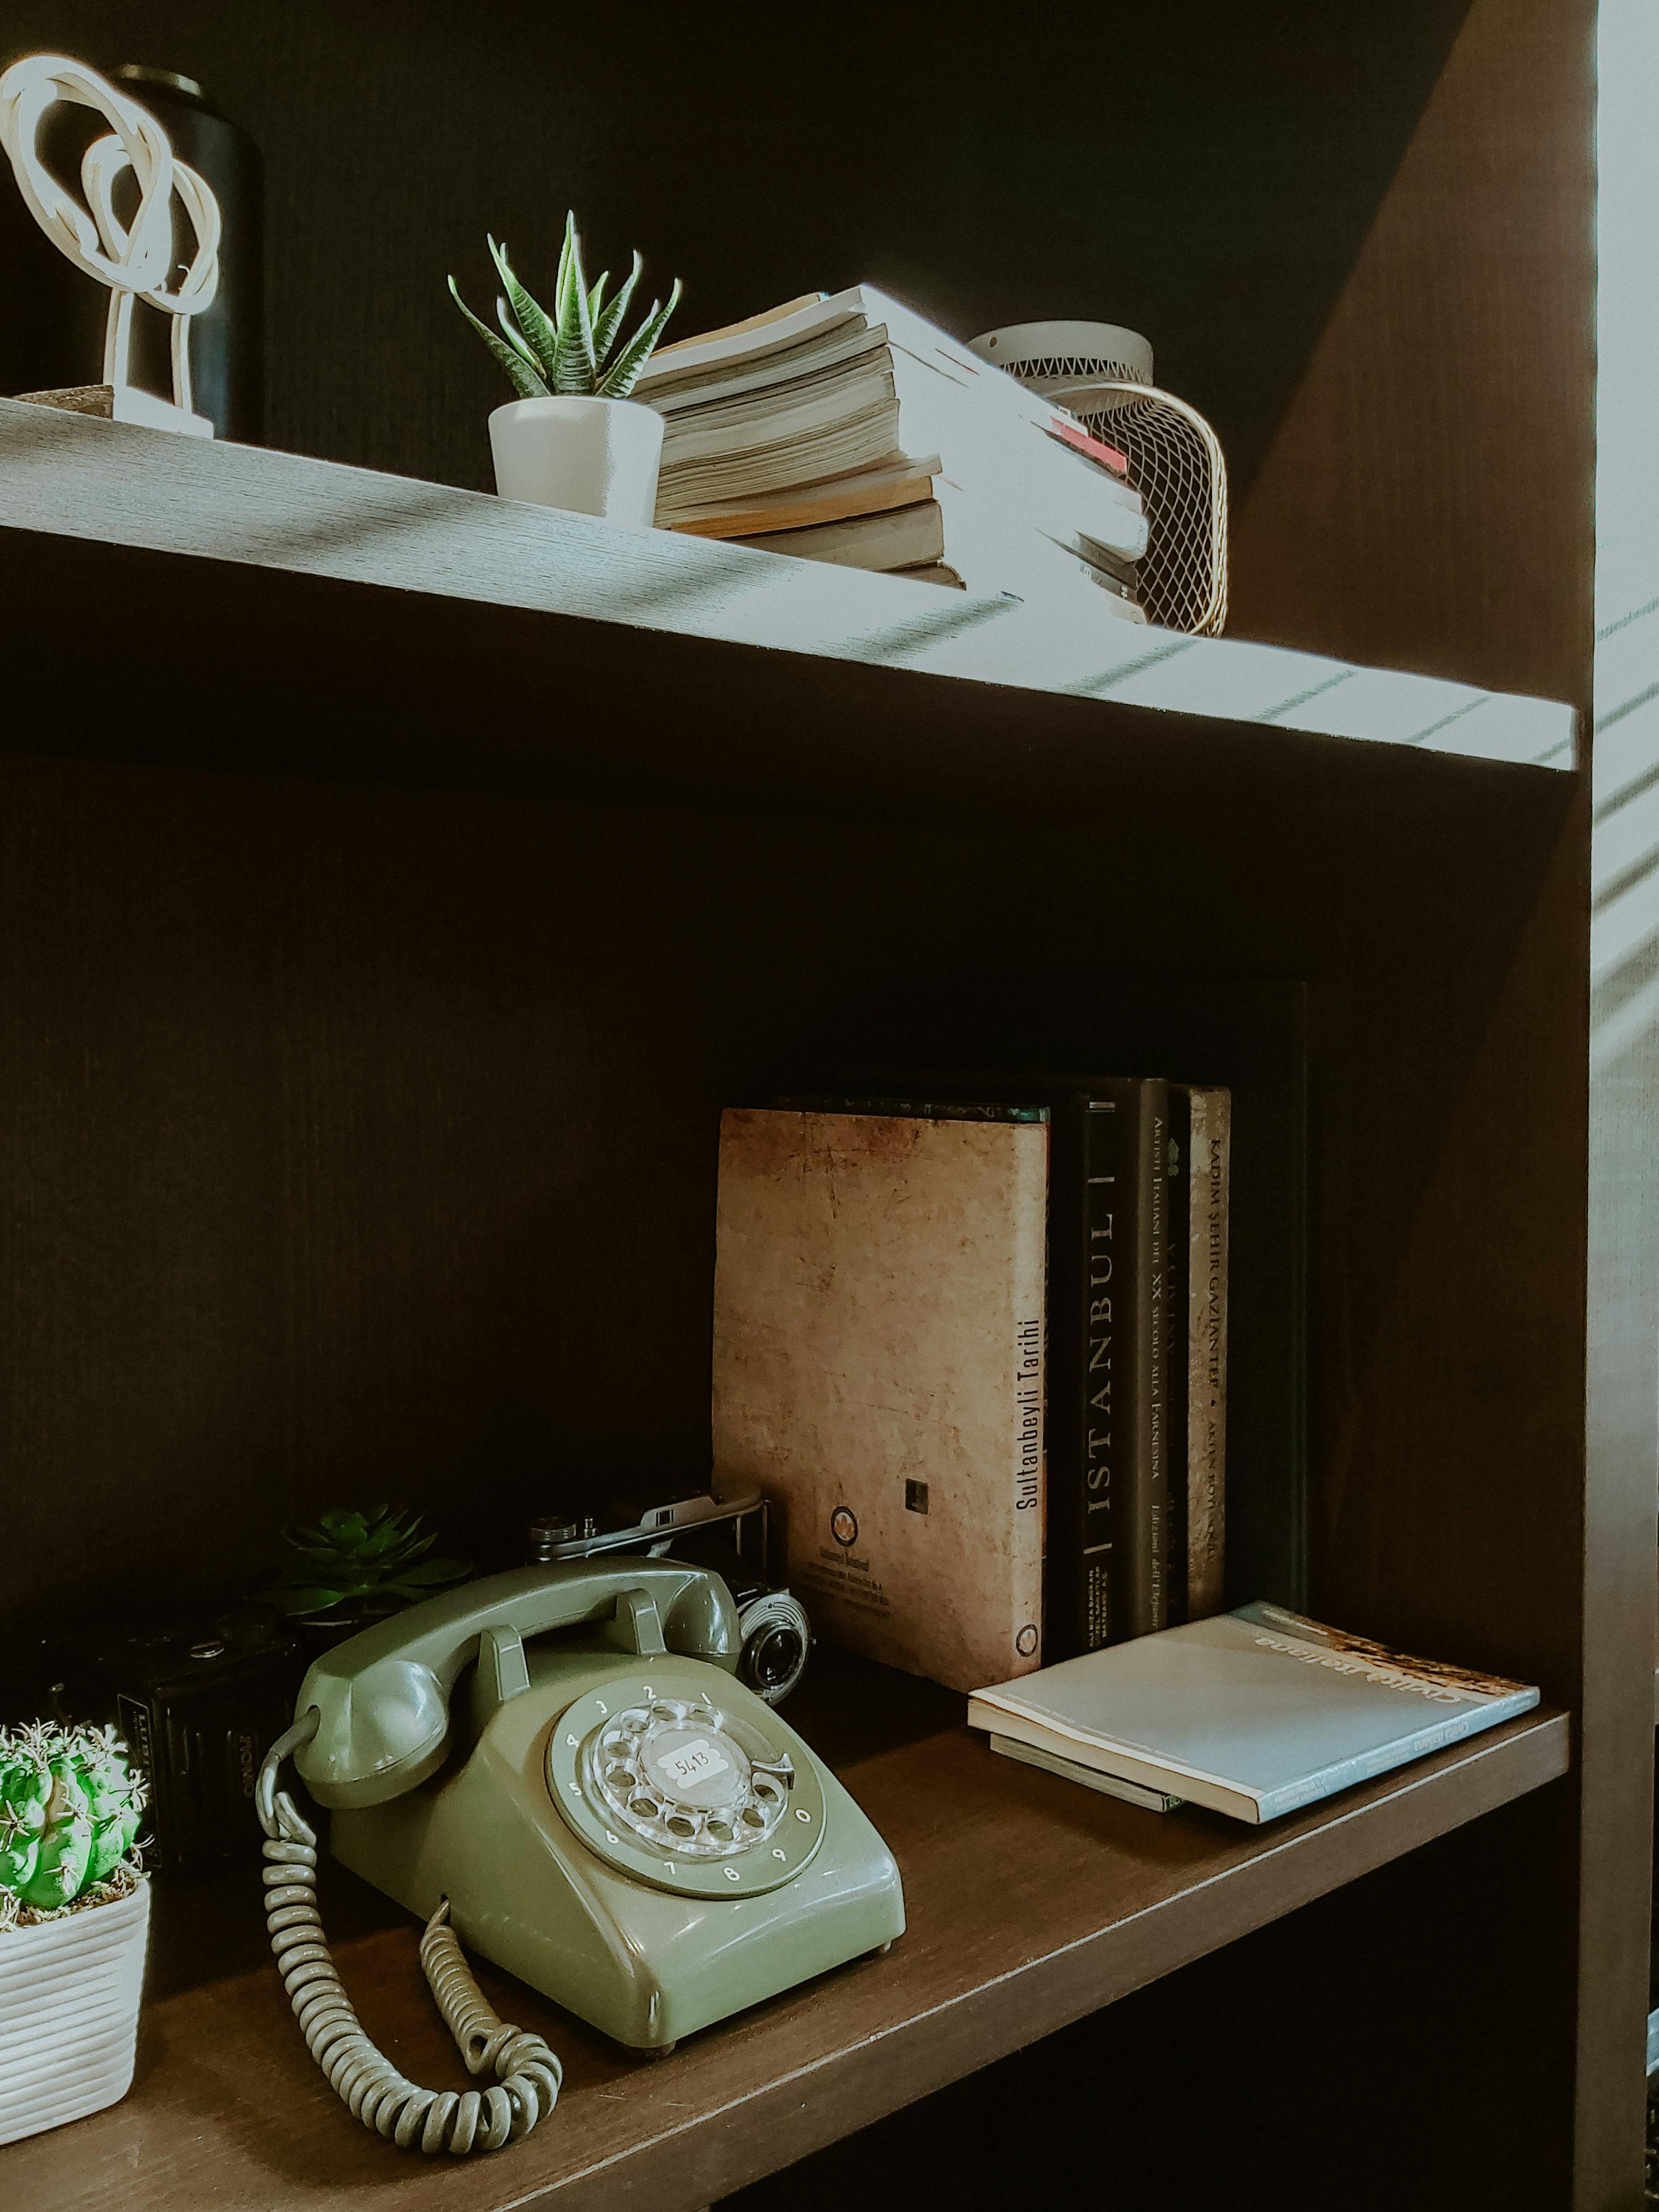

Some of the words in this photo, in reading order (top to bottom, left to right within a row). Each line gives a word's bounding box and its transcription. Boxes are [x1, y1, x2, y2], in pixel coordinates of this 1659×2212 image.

[1152, 1273, 1162, 1300] XX
[1017, 1320, 1040, 1382] Tarihi
[1087, 1213, 1113, 1515] ISTANBUL
[1017, 1389, 1040, 1510] Sultanbeyli
[643, 1685, 656, 1700] 2
[700, 1691, 712, 1706] 1
[595, 1700, 608, 1714] 3
[566, 1733, 580, 1748] 4
[674, 1751, 711, 1776] 5413
[569, 1781, 583, 1797] 5
[794, 1808, 812, 1824] 0
[606, 1829, 619, 1844] 6
[771, 1849, 787, 1863] 9
[663, 1861, 676, 1875] 7
[722, 1866, 740, 1882] 8
